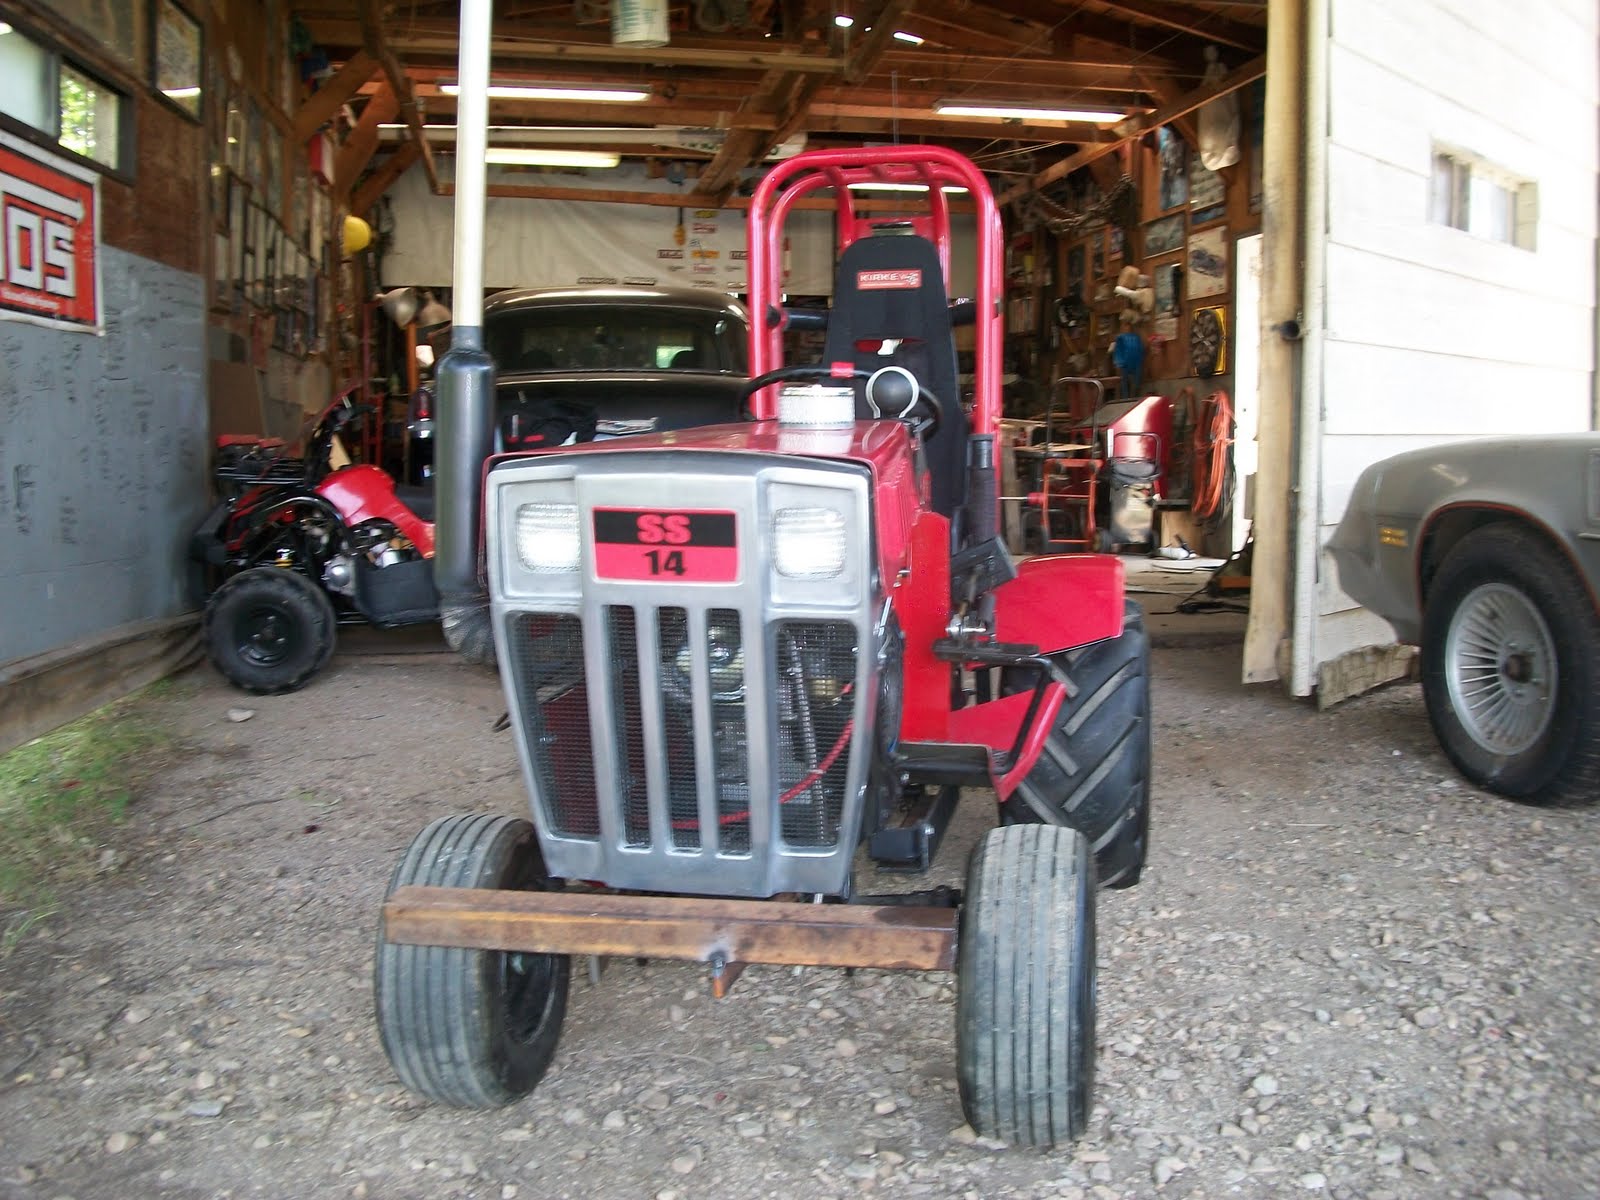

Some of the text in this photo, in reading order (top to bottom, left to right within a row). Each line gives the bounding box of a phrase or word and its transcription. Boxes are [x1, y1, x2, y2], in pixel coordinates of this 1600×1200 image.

[0, 198, 76, 298] OS
[636, 513, 692, 545] SS
[644, 549, 687, 576] 14
